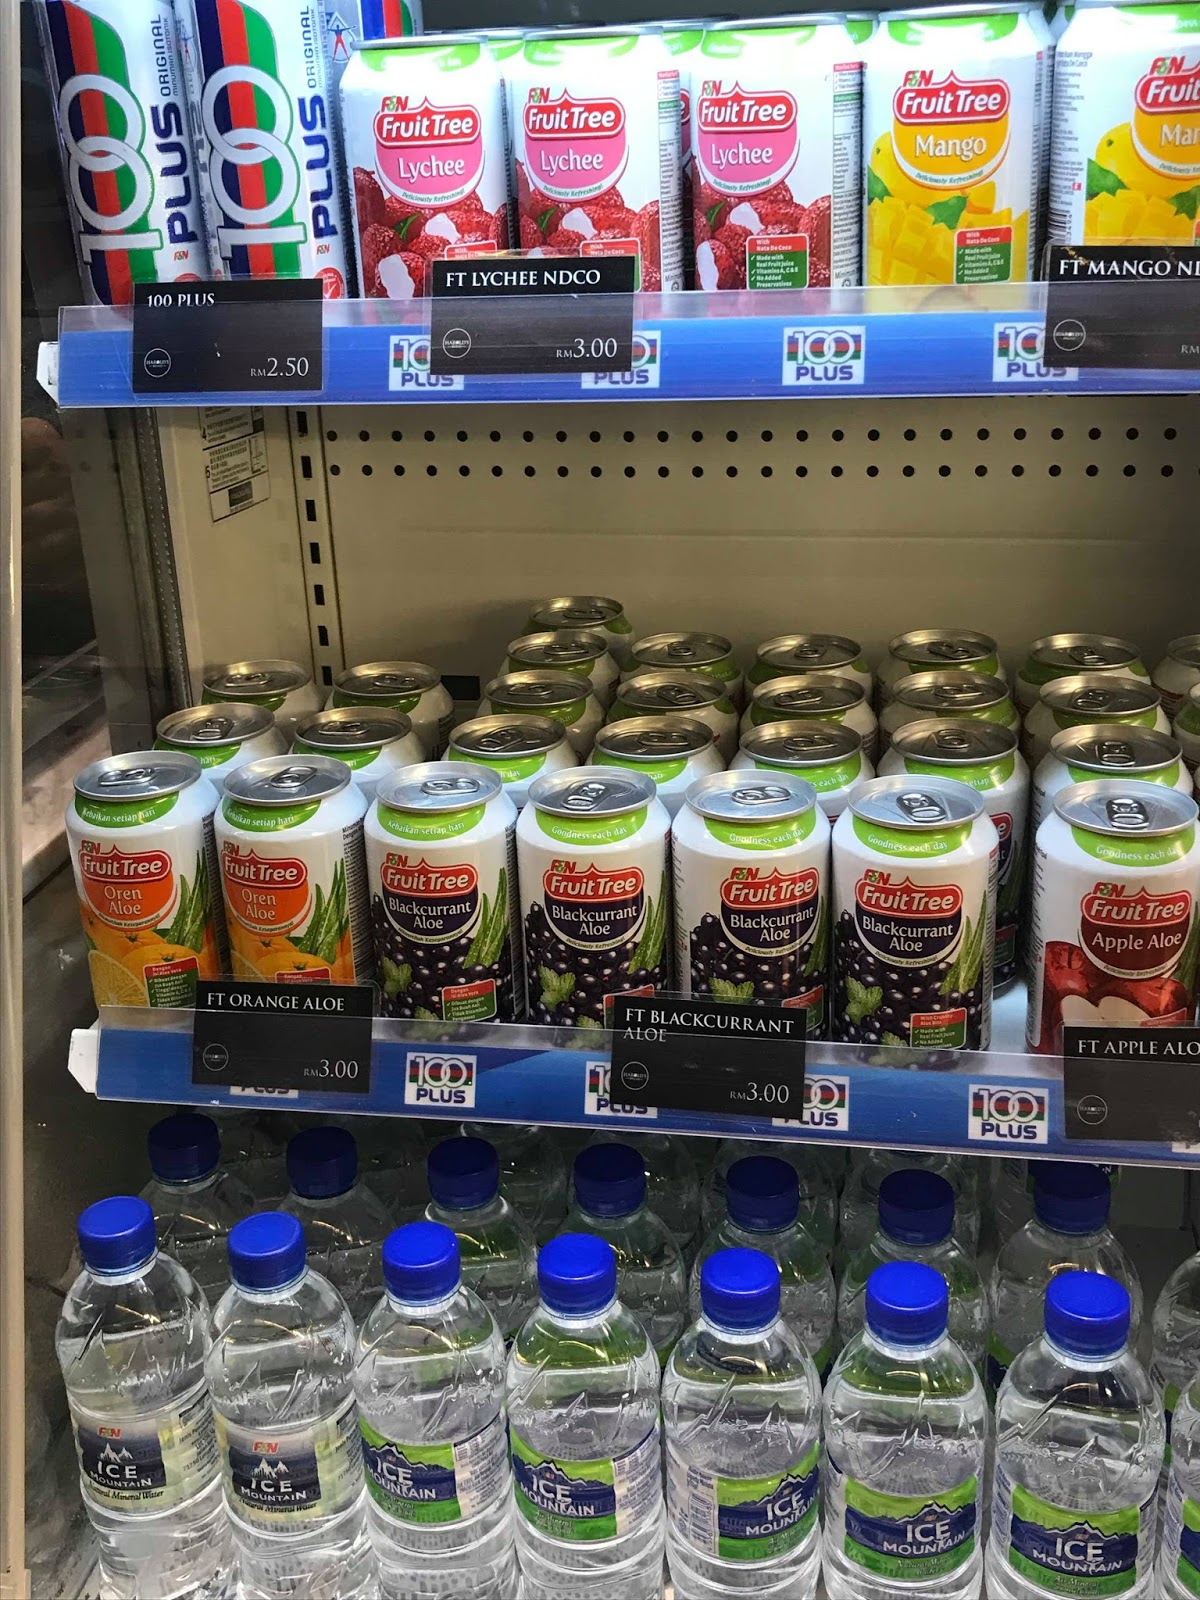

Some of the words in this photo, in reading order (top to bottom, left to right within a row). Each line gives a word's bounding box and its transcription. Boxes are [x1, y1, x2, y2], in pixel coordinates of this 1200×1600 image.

[151, 14, 171, 96] ORIGINAL
[300, 5, 317, 88] ORIGINAL
[1150, 56, 1185, 75] F&N
[903, 70, 933, 87] F&N
[528, 88, 550, 103] F&N
[702, 80, 722, 97] F&N
[381, 96, 409, 112] F&N
[701, 100, 740, 123] Fruit
[741, 100, 787, 121] Tree
[901, 92, 954, 116] Fruit
[955, 91, 1001, 113] Tree
[381, 115, 428, 138] Fruit
[433, 113, 474, 134] Tree
[528, 107, 570, 130] Fruit
[571, 105, 615, 127] Tree
[712, 144, 773, 170] Lychee
[915, 135, 987, 162] Mango
[59, 74, 163, 264] 100
[200, 65, 307, 260] 100
[298, 94, 338, 240] PLUS
[398, 155, 465, 183] Lychee
[540, 149, 603, 177] Lychee
[150, 101, 199, 245] PLUS
[1059, 259, 1083, 275] FT
[1087, 259, 1172, 276] MANGO
[446, 272, 467, 287] FT
[472, 270, 538, 287] LYCHEE
[543, 269, 601, 286] NDCO
[147, 294, 172, 308] 100
[177, 293, 215, 307] PLUS
[795, 330, 855, 364] 100
[401, 373, 454, 387] PLUS
[796, 365, 853, 381] PLUS
[112, 812, 138, 823] setiap
[252, 818, 276, 828] setiap
[422, 826, 446, 836] setiap
[552, 826, 592, 839] Goodness
[593, 830, 612, 839] each
[729, 832, 771, 845] Goodness
[774, 832, 790, 842] each
[81, 840, 100, 853] F&N
[224, 840, 240, 857] F&N
[868, 834, 906, 850] Goodness
[907, 842, 930, 850] each
[386, 853, 408, 867] F&N
[1096, 846, 1141, 860] Goodness
[1144, 851, 1164, 860] each
[83, 858, 120, 876] Fruit
[121, 858, 163, 874] Tree
[225, 858, 256, 879] Fruit
[257, 864, 297, 881] Tree
[551, 860, 576, 874] F&N
[730, 867, 760, 881] F&N
[386, 871, 427, 891] Fruit
[428, 872, 469, 889] Tree
[864, 869, 891, 885] F&N
[104, 885, 142, 900] Oren
[551, 878, 595, 897] Fruit
[597, 876, 637, 896] Tree
[729, 883, 776, 902] Fruit
[776, 876, 812, 899] Tree
[1094, 882, 1125, 897] F&N
[242, 888, 276, 905] Oren
[863, 886, 909, 909] Fruit
[911, 891, 954, 910] Tree
[109, 900, 142, 915] Aloe
[245, 905, 276, 921] Aloe
[389, 896, 471, 916] Blackcurrant
[552, 904, 638, 923] Blackcurrant
[1091, 900, 1143, 920] Fruit
[1146, 900, 1184, 920] Tree
[413, 914, 444, 930] Aloe
[730, 907, 814, 929] Blackcurrant
[862, 916, 954, 937] Blackcurrant
[579, 922, 611, 936] Aloe
[760, 926, 791, 942] Aloe
[889, 936, 923, 952] Aloe
[1092, 932, 1143, 953] Apple
[1149, 930, 1182, 948] Aloe
[207, 992, 226, 1007] FT
[229, 993, 300, 1011] ORANGE
[303, 996, 344, 1012] ALOE
[625, 1008, 646, 1024] FT
[651, 1010, 795, 1034] BLACKCURRANT
[623, 1026, 667, 1043] ALOE
[1078, 1040, 1100, 1054] FT
[1106, 1040, 1158, 1055] APPLE
[413, 1057, 469, 1088] 100
[416, 1089, 466, 1104] PLUS
[979, 1090, 1039, 1124] 100
[981, 1124, 1037, 1140] PLUS
[99, 1427, 122, 1439] F&N
[253, 1441, 279, 1454] F&N
[90, 1471, 152, 1488] MOUNTAIN
[98, 1462, 137, 1479] ICE
[377, 1457, 413, 1486] ICE
[251, 1480, 292, 1498] ICE
[367, 1468, 436, 1499] MOUNTAIN
[532, 1474, 572, 1503] ICE
[112, 1491, 142, 1500] Mineral
[142, 1489, 164, 1500] Water
[241, 1486, 307, 1502] MOUNTAIN
[520, 1482, 595, 1516] MOUNTAIN
[766, 1488, 804, 1520] ICE
[906, 1519, 951, 1542] ICE
[883, 1531, 965, 1555] MOUNTAIN
[1056, 1537, 1104, 1561] ICE
[1032, 1549, 1122, 1575] MOUNTAIN
